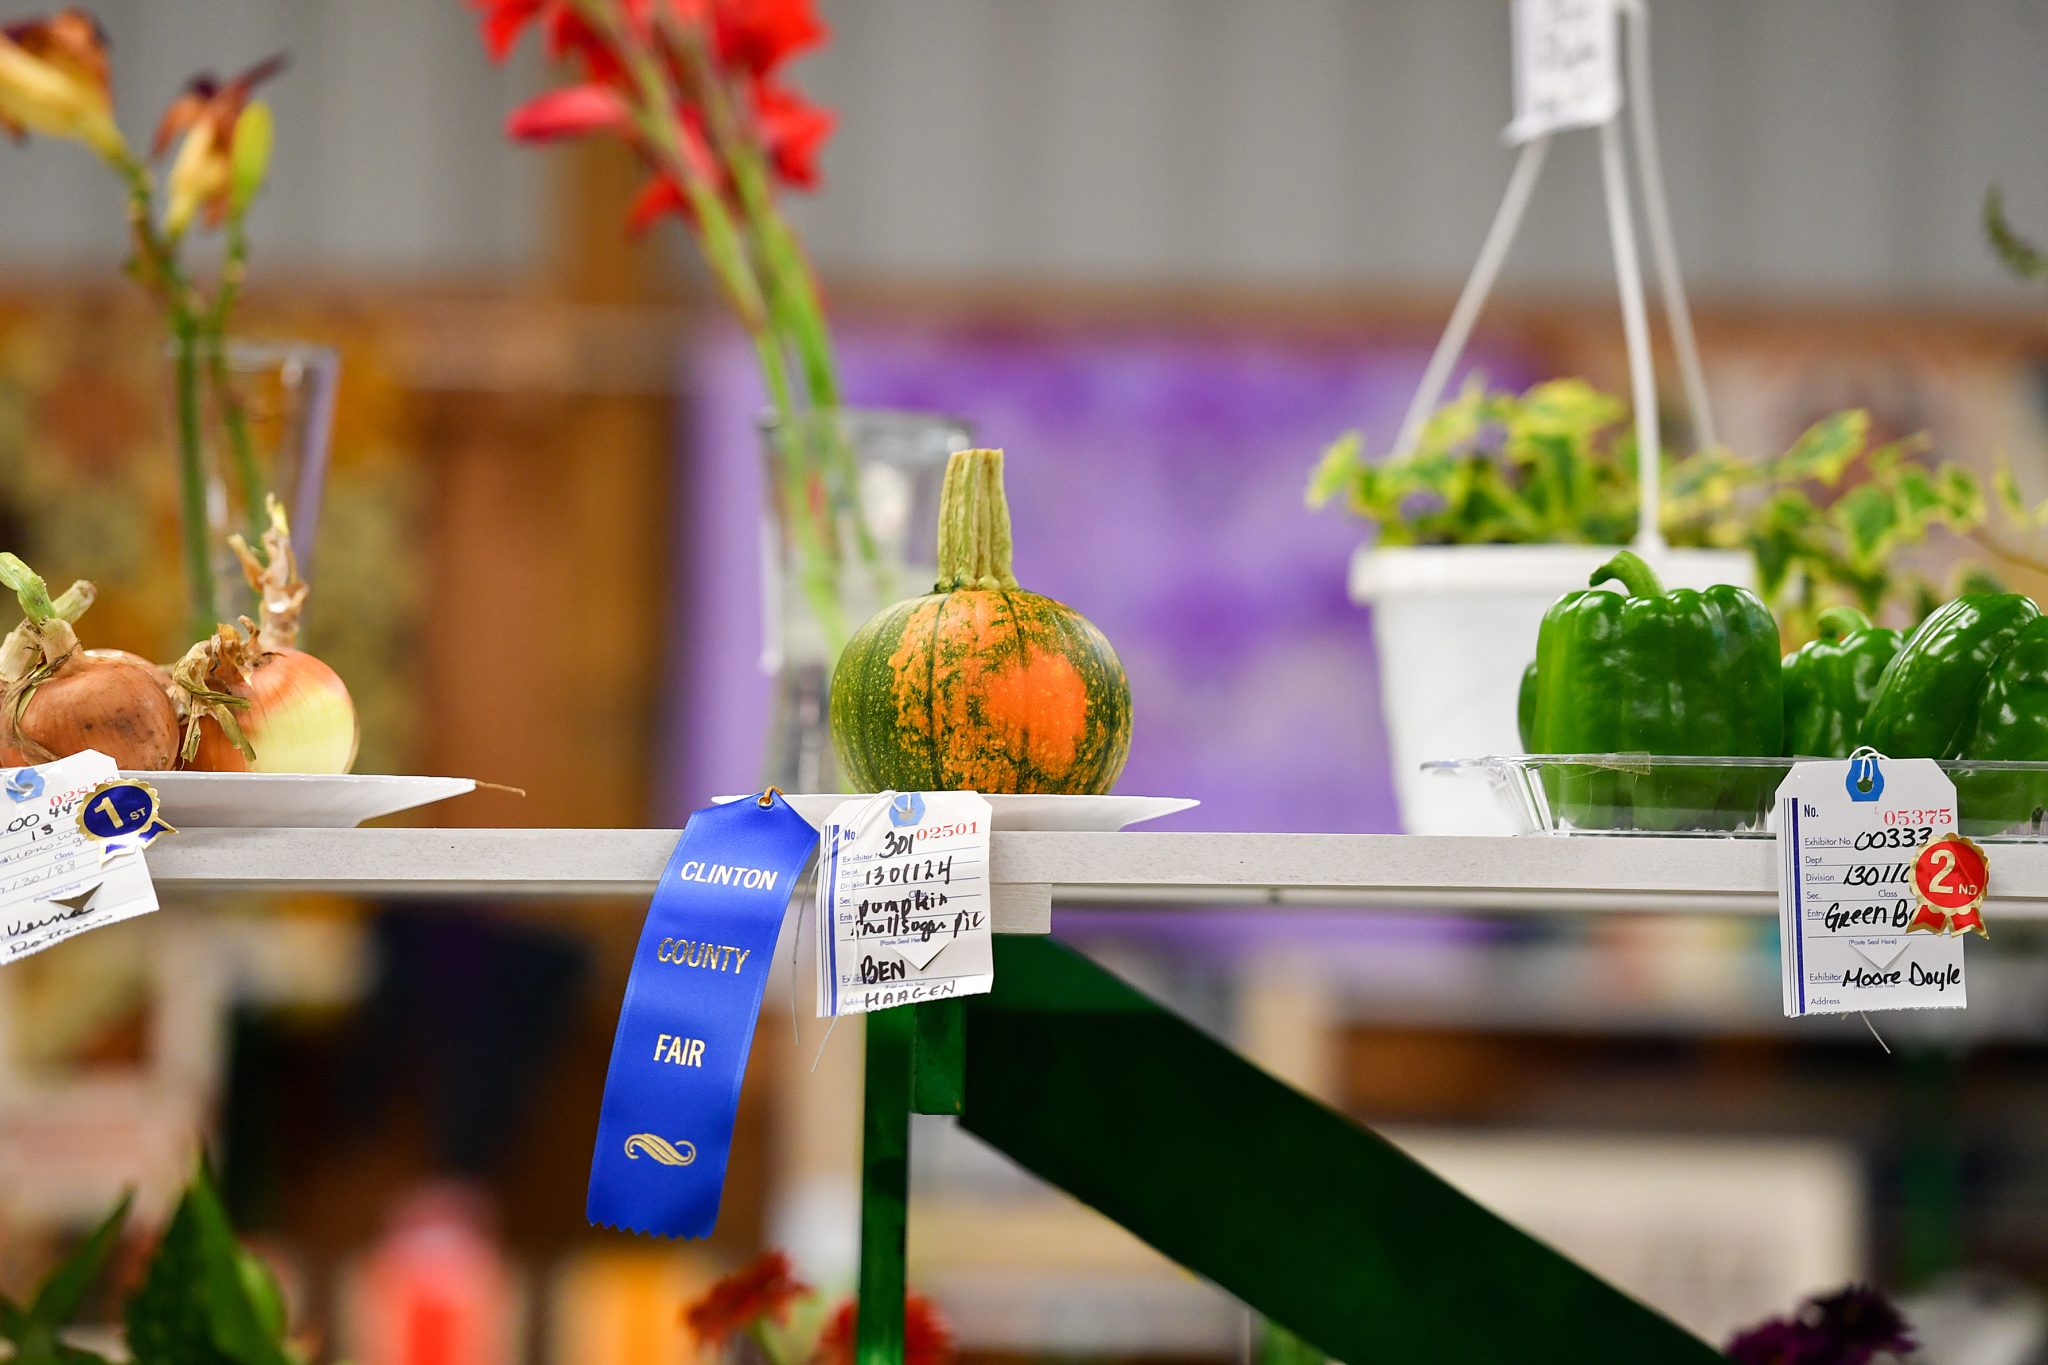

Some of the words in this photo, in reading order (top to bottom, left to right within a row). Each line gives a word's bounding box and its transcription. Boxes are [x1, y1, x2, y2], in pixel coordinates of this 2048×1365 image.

[50, 776, 115, 806] 028
[129, 807, 146, 821] ST
[1804, 804, 1819, 818] No.
[1883, 808, 1952, 826] 05375
[844, 829, 859, 840] No.
[916, 822, 980, 841] 02501
[879, 830, 914, 858] 301
[1804, 837, 1837, 846] Exhibitor
[1839, 837, 1852, 846] No.
[1854, 827, 1932, 851] 00333
[681, 861, 778, 891] CLINTON
[865, 856, 953, 885] 1301124
[1805, 873, 1835, 882] Division
[1929, 849, 1956, 894] 2
[1958, 883, 1978, 896] ND
[1806, 891, 1821, 900] Sec.
[1878, 889, 1898, 898] Class
[1807, 909, 1826, 920] Entry
[657, 937, 750, 975] COUNTY
[860, 955, 906, 985] BEN
[1809, 972, 1842, 982] Exhibitor
[1842, 967, 1902, 987] Moore
[1908, 961, 1961, 991] Doyle
[864, 980, 956, 1008] HAAGEN
[1810, 997, 1841, 1006] Address
[653, 1034, 706, 1068] FAIR
